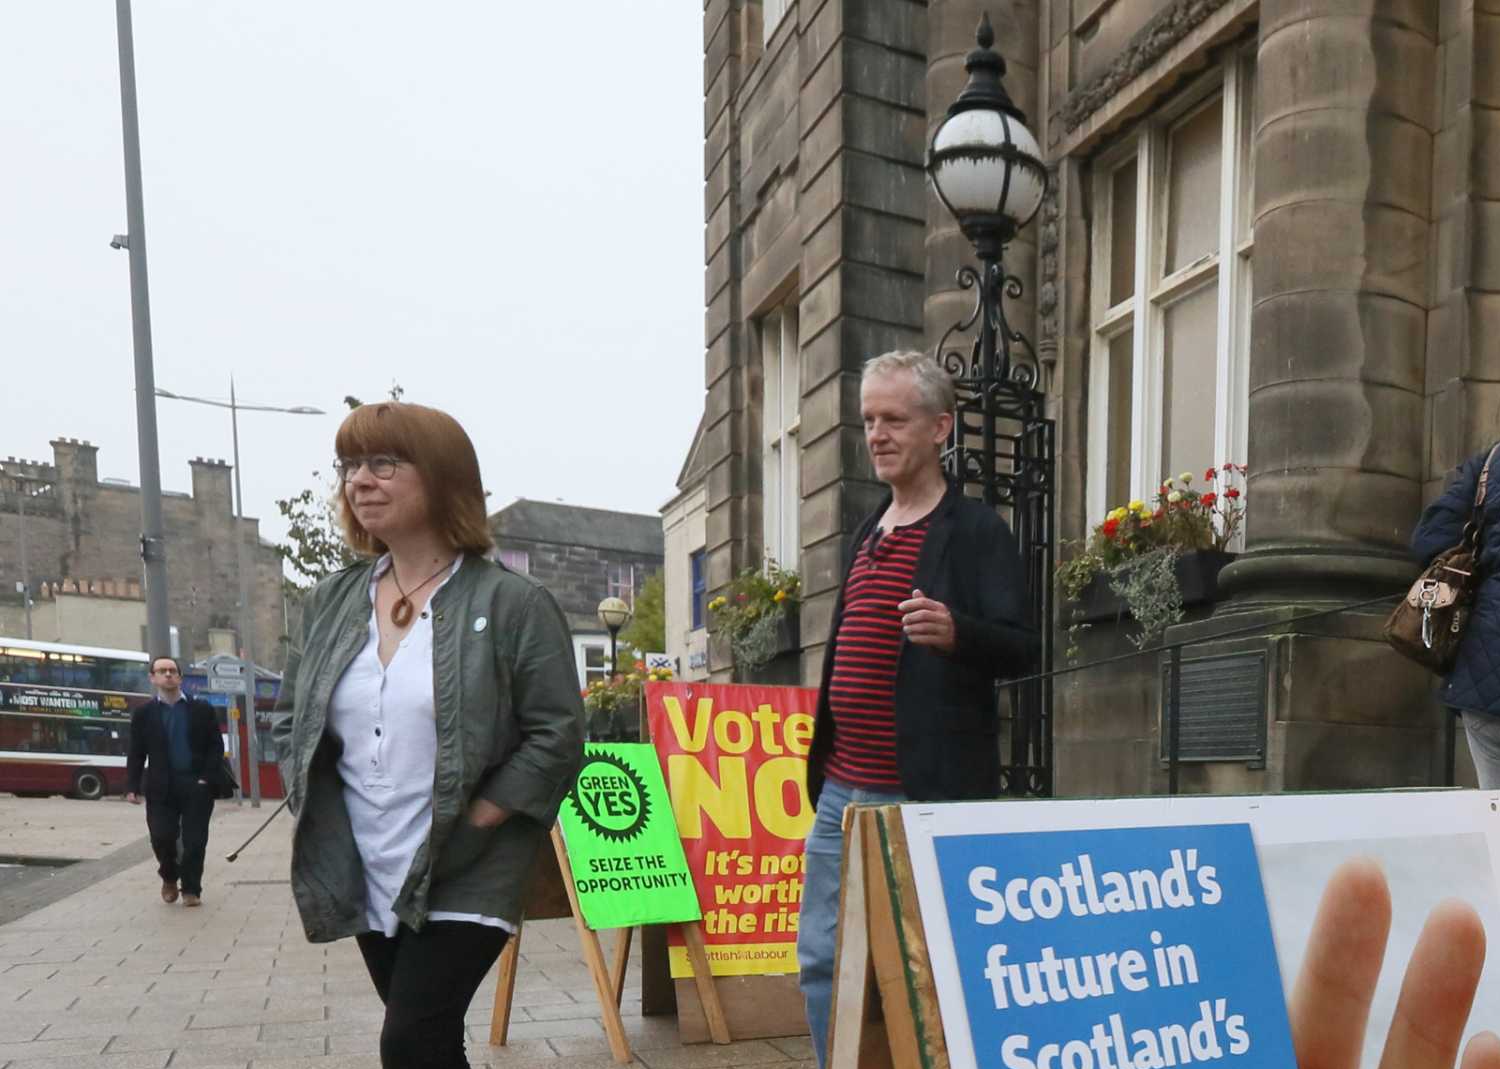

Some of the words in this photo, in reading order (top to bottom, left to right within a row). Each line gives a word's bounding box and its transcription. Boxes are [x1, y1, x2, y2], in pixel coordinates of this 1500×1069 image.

[662, 695, 815, 755] Vote
[579, 776, 630, 790] GREEN
[583, 791, 637, 817] YES
[668, 754, 816, 840] NO
[589, 857, 633, 873] SEIZE
[635, 855, 667, 870] THE
[704, 849, 753, 876] It's
[576, 872, 689, 894] OPPORTUNITY
[715, 878, 803, 905] worth
[967, 848, 1221, 925] Scotland's
[704, 908, 758, 935] the
[763, 907, 800, 934] ris
[984, 943, 1148, 1010] future
[1149, 931, 1198, 988] in
